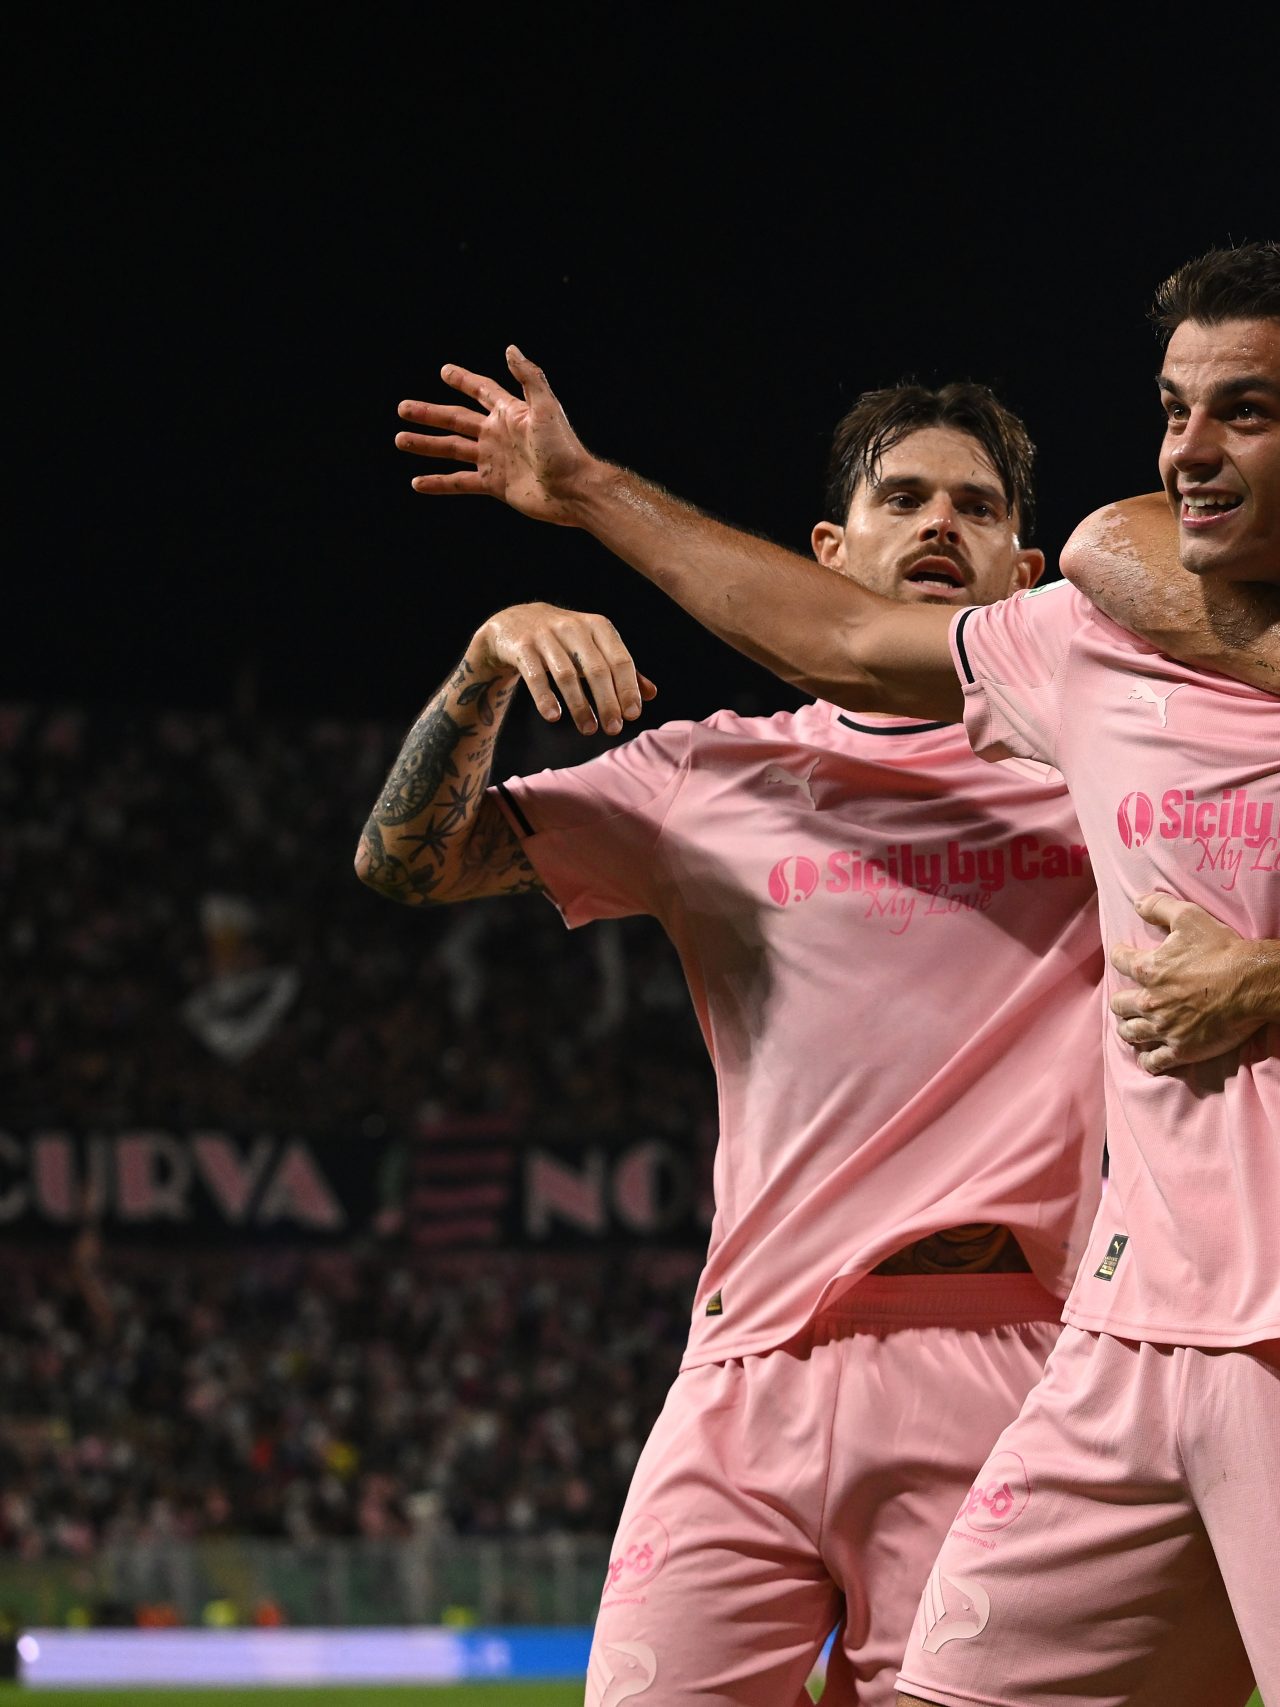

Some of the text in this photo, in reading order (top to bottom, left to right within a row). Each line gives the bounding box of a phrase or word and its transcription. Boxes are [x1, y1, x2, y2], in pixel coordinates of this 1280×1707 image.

[1159, 789, 1274, 849] Sicily
[825, 834, 1088, 896] Sicily by Car
[1192, 836, 1243, 892] My
[863, 882, 992, 936] My Love
[523, 1140, 715, 1238] NO
